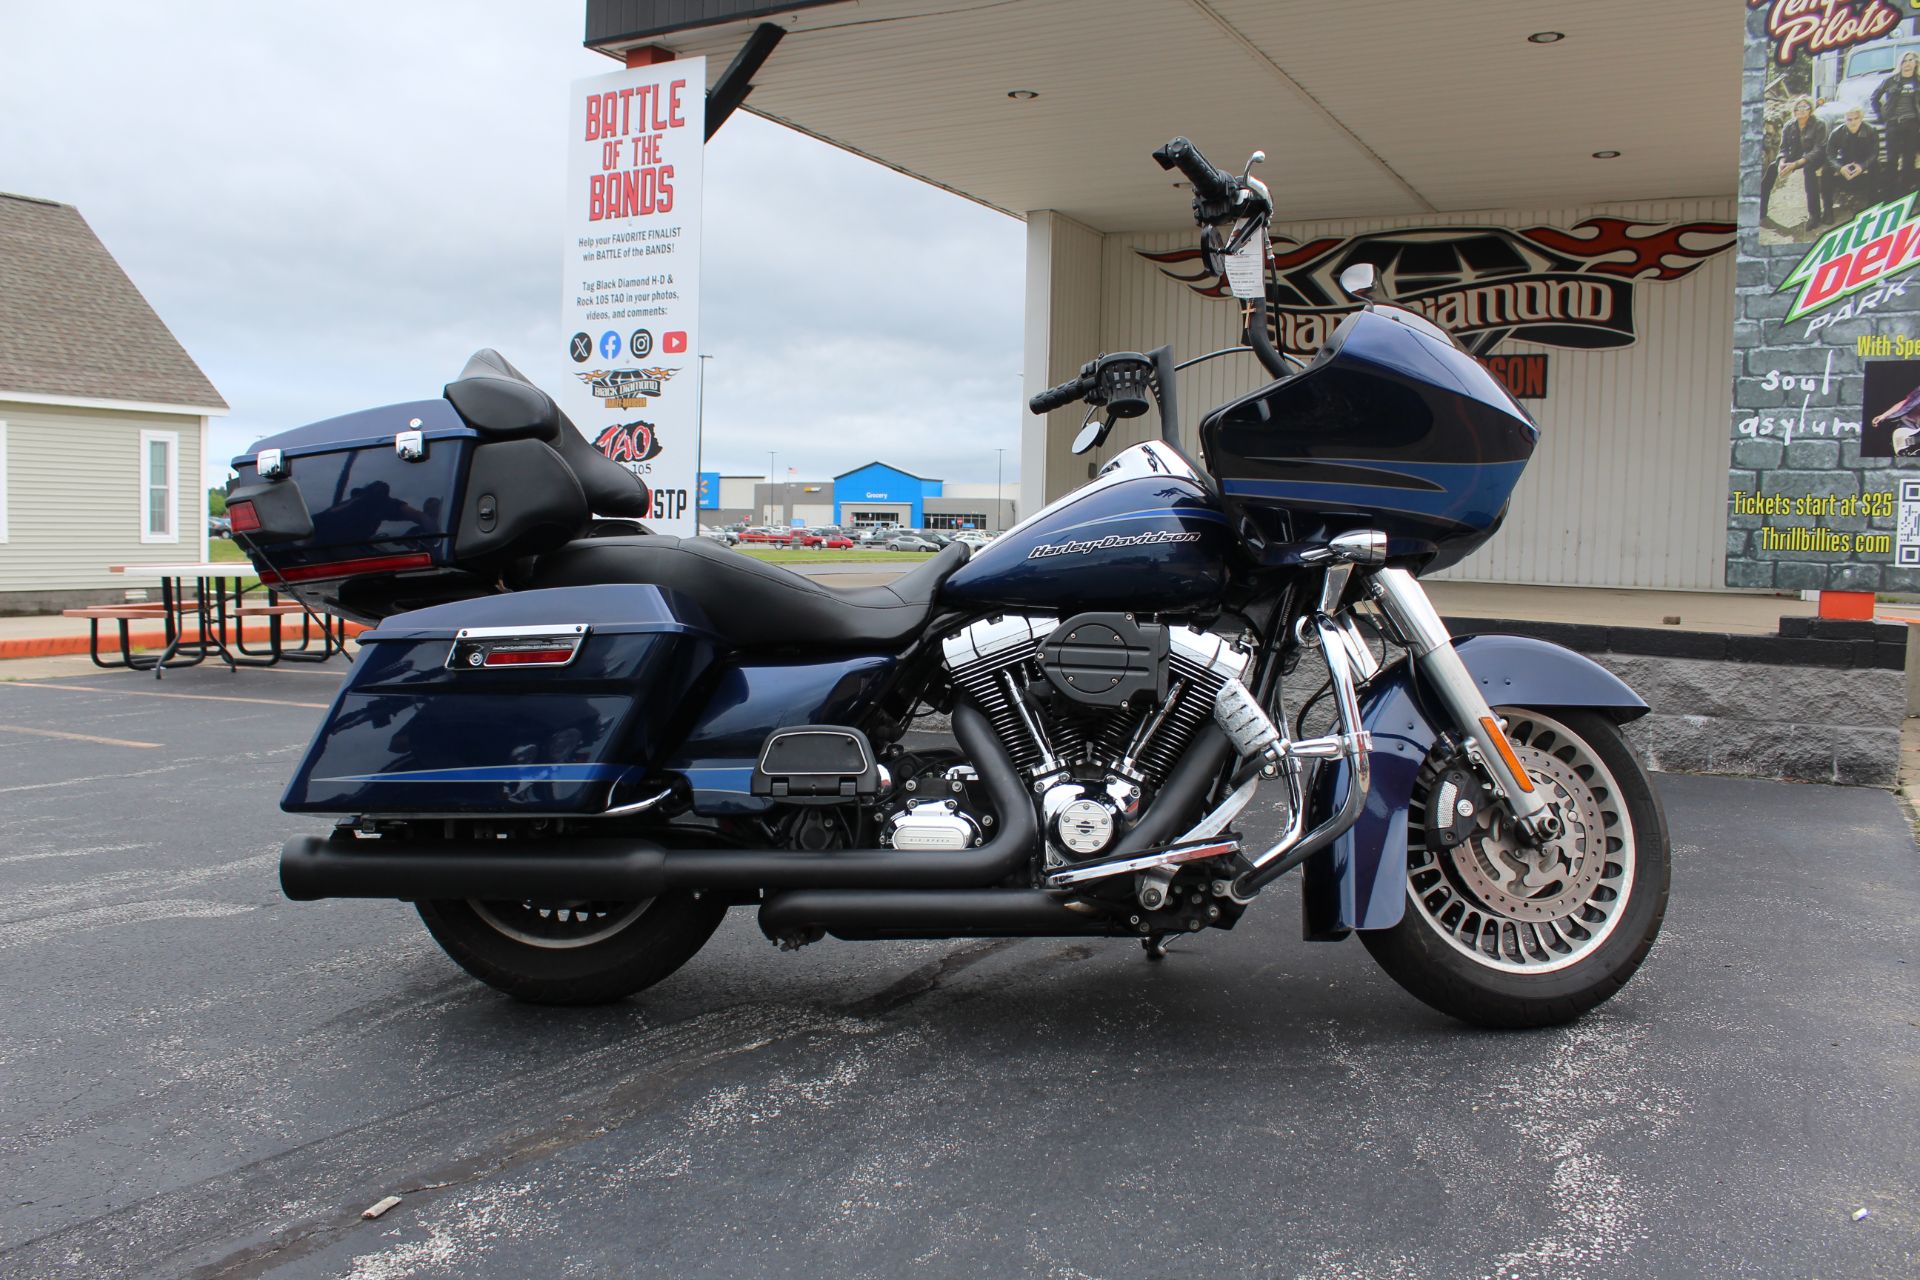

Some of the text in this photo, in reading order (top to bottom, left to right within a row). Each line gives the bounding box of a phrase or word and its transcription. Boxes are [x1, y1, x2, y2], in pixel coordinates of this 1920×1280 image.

[1775, 1, 1899, 60] Pilots
[585, 79, 686, 142] BATTLE
[602, 134, 663, 171] OF THE
[588, 165, 674, 222] BANDS
[578, 227, 681, 248] Help your FAVORITE FINALIST
[583, 243, 675, 261] win BATTLE of the BANDS!
[582, 274, 674, 293] Tag Black Diamond H-D &
[576, 296, 593, 306] Rock
[595, 294, 609, 305] 105
[626, 293, 633, 302] in
[634, 293, 650, 304] your
[1803, 275, 1914, 339] PARK
[612, 308, 625, 319] and
[1857, 334, 1890, 357] With
[1738, 393, 1863, 446] asylum
[632, 463, 652, 475] 105
[1733, 491, 1893, 517] Tickets start at $25
[1028, 531, 1201, 559] Harley-Davidson
[1762, 526, 1890, 553] Thrillbillies.com
